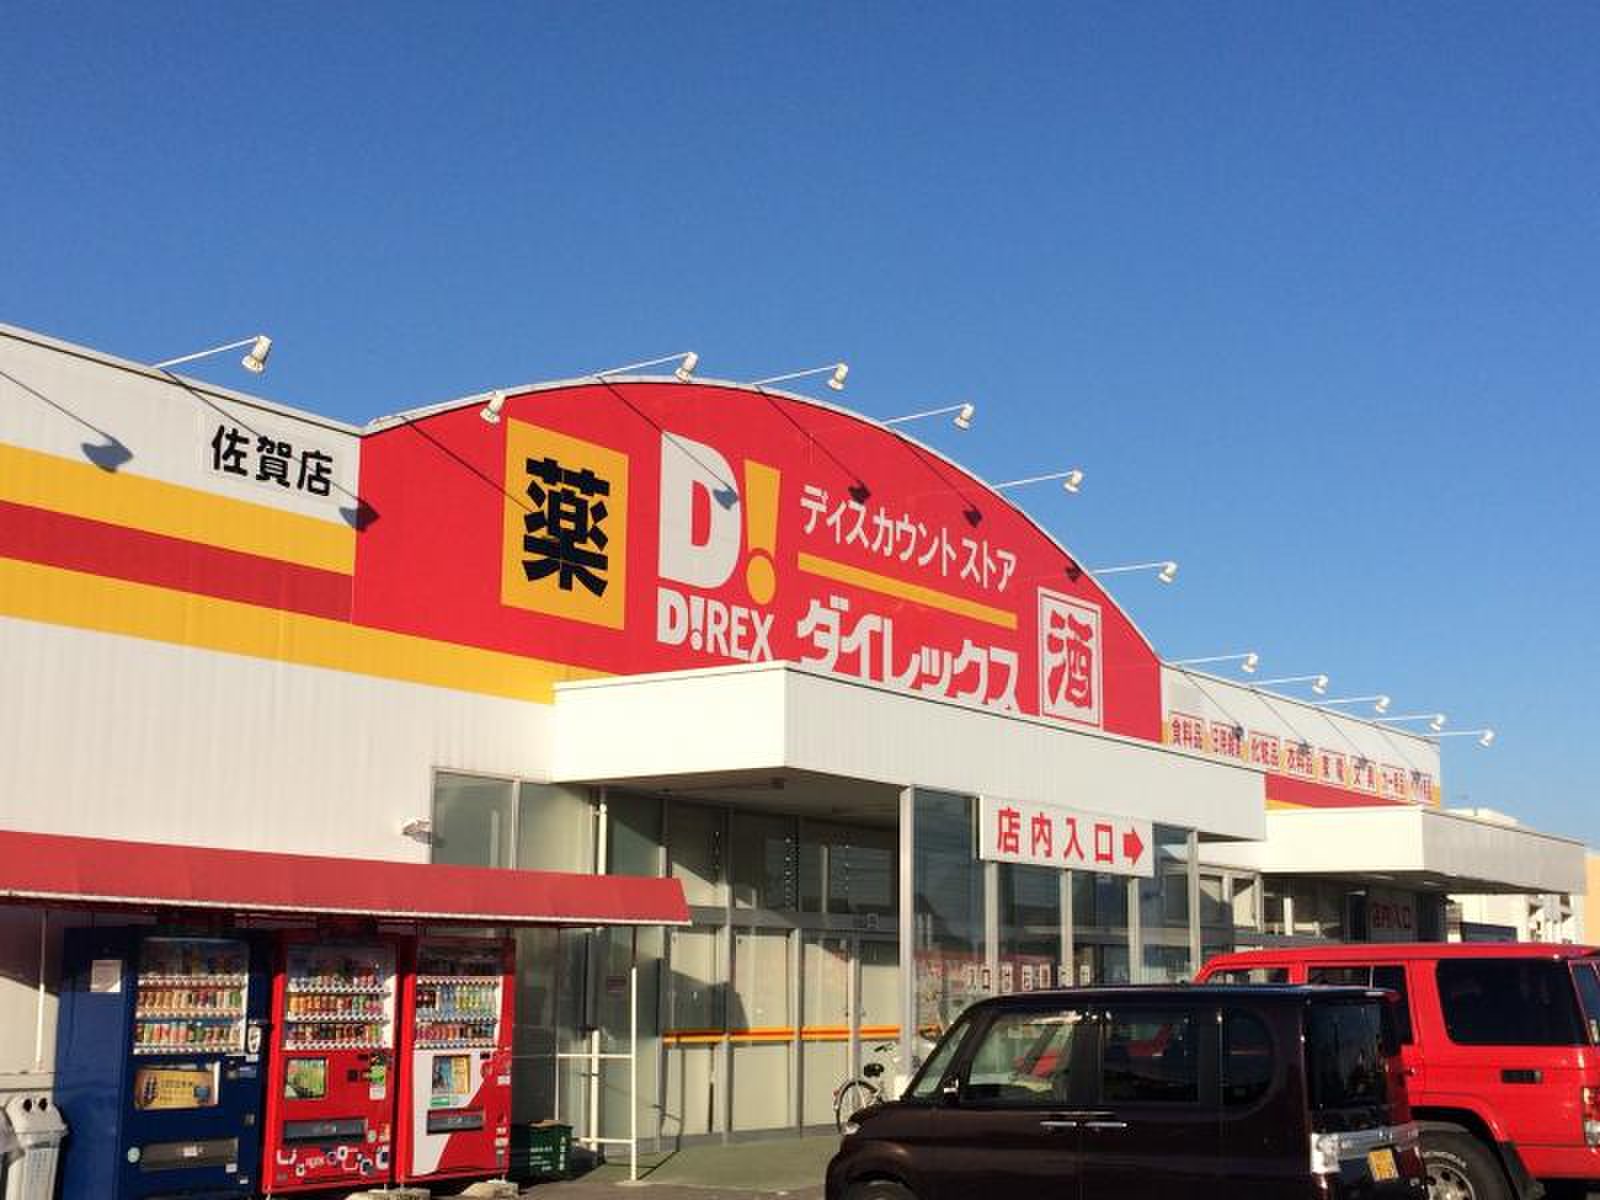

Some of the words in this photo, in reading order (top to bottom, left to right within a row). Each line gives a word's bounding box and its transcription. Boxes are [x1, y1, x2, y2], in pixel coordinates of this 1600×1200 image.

[211, 425, 333, 496] 佐賀店
[521, 457, 611, 598] 薬
[797, 595, 1020, 715] ダイレックス
[1171, 719, 1202, 749] 食料品
[1250, 737, 1280, 767] 化粧品
[997, 807, 1114, 864] 店内入口
